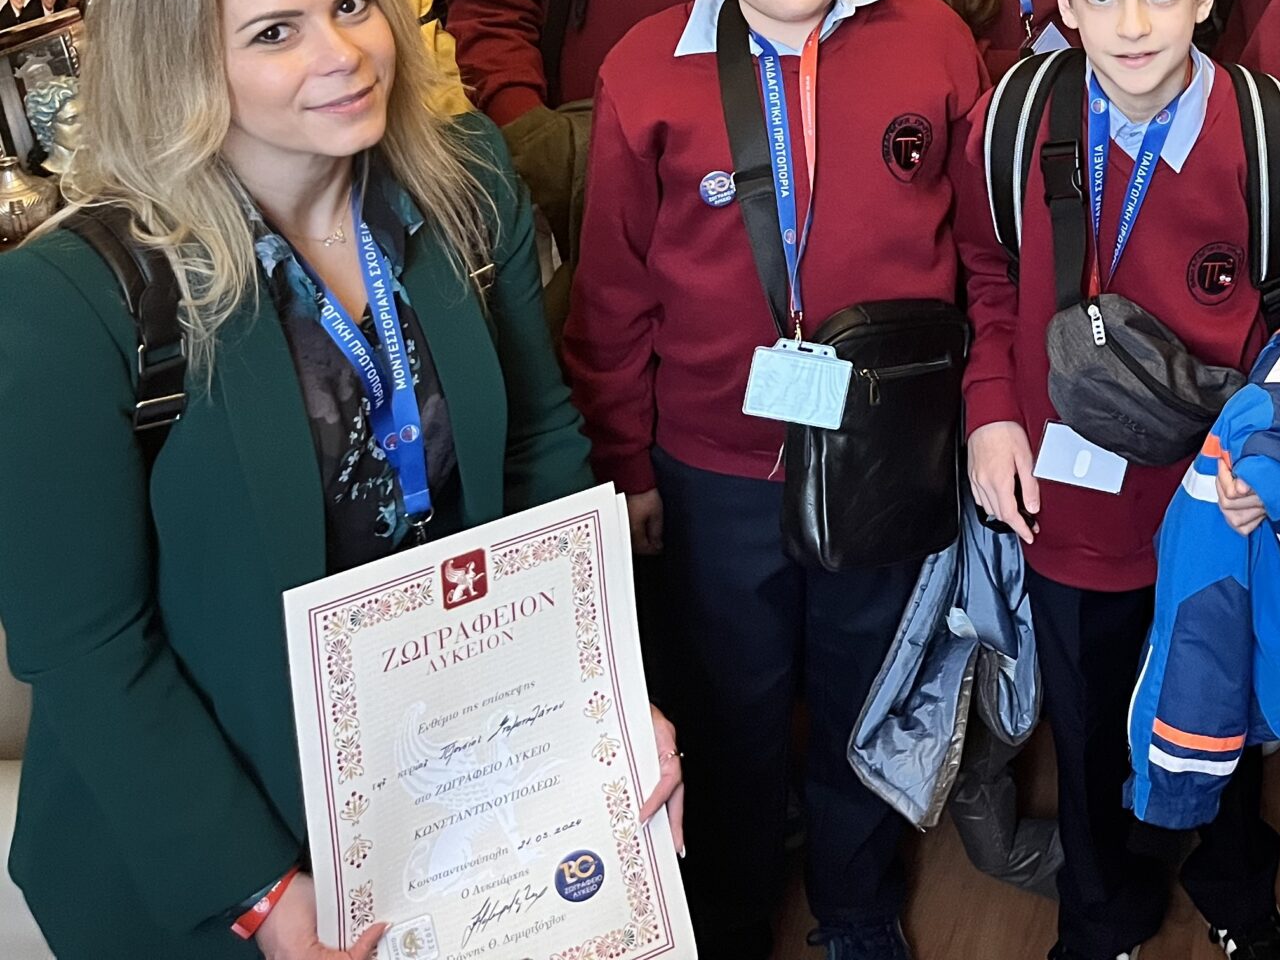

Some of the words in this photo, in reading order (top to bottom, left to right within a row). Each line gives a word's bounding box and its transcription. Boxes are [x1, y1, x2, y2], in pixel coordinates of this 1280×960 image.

[764, 55, 783, 126] ΠΑΙΔΑΓΩΓΙΚΗ
[773, 127, 791, 198] ΠΡΩΤΟΠΟΡΙΑ
[1094, 143, 1104, 192] ΣΧΟΛΕΙΑ
[1124, 150, 1154, 221] ΠΑΙΔΑΓΩΓΙΚΗ
[360, 222, 381, 277] ΣΧΟΛΕΙΑ
[373, 279, 407, 390] ΜΟΝΤΕΣΣΟΡΙΑΝΑ
[348, 339, 384, 409] ΠΡΩΤΟΠΟΡΙΑ
[382, 587, 556, 673] ΖΩΓΡΑΦΕΙΟΝ
[426, 627, 514, 675] ΛΥΚΕΙΟΝ
[434, 760, 502, 797] ΖΩΓΡΑΦΕΙΟ
[505, 742, 551, 768] ΛΥΚΕΙΟ
[413, 774, 561, 841] ΚΩΝΣΤΑΝΤΙΝΟΥΠΟΛΕΩΣ
